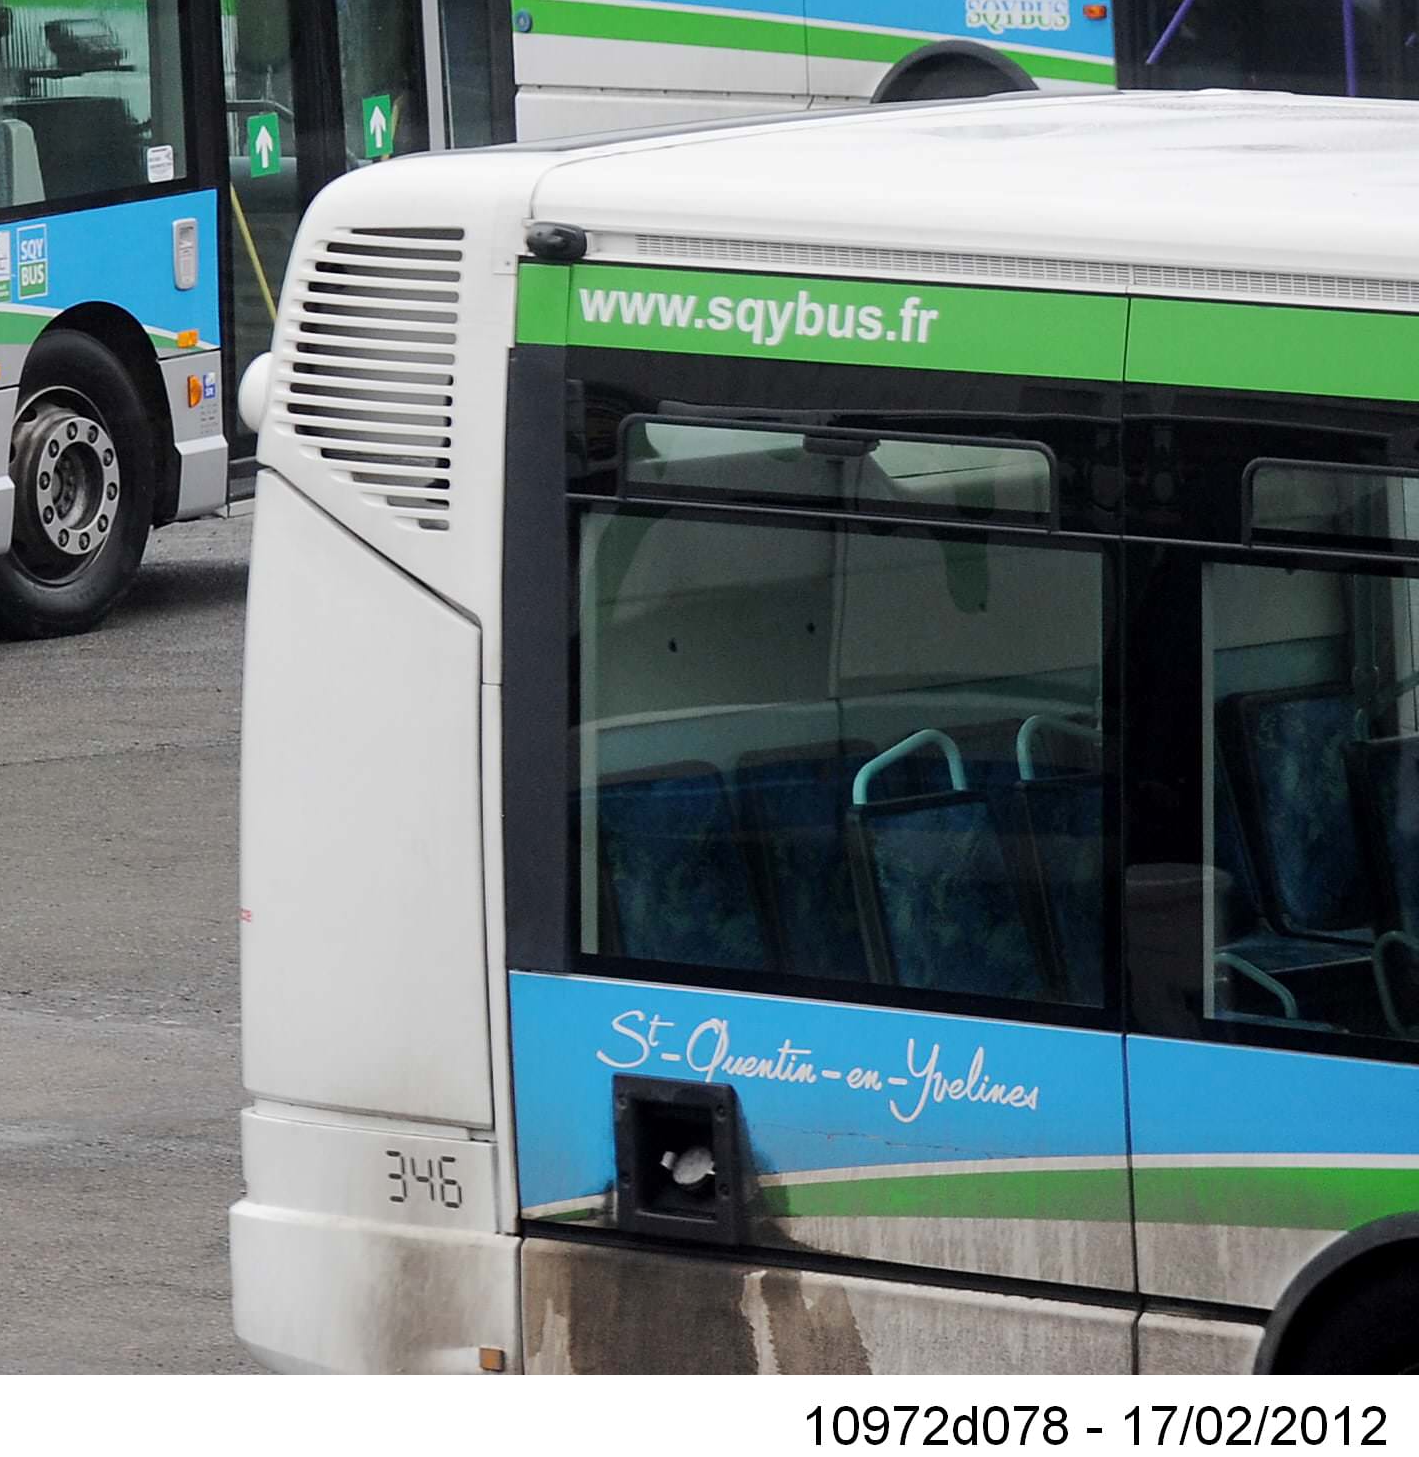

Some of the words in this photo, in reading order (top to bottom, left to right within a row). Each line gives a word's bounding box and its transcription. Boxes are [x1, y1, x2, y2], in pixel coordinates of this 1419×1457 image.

[21, 238, 43, 260] SQY
[22, 263, 44, 287] BUS
[579, 290, 939, 346] www.sqybus.fr
[596, 1010, 1040, 1123] St-Quentin-en-Yvelines
[386, 1150, 462, 1209] 346
